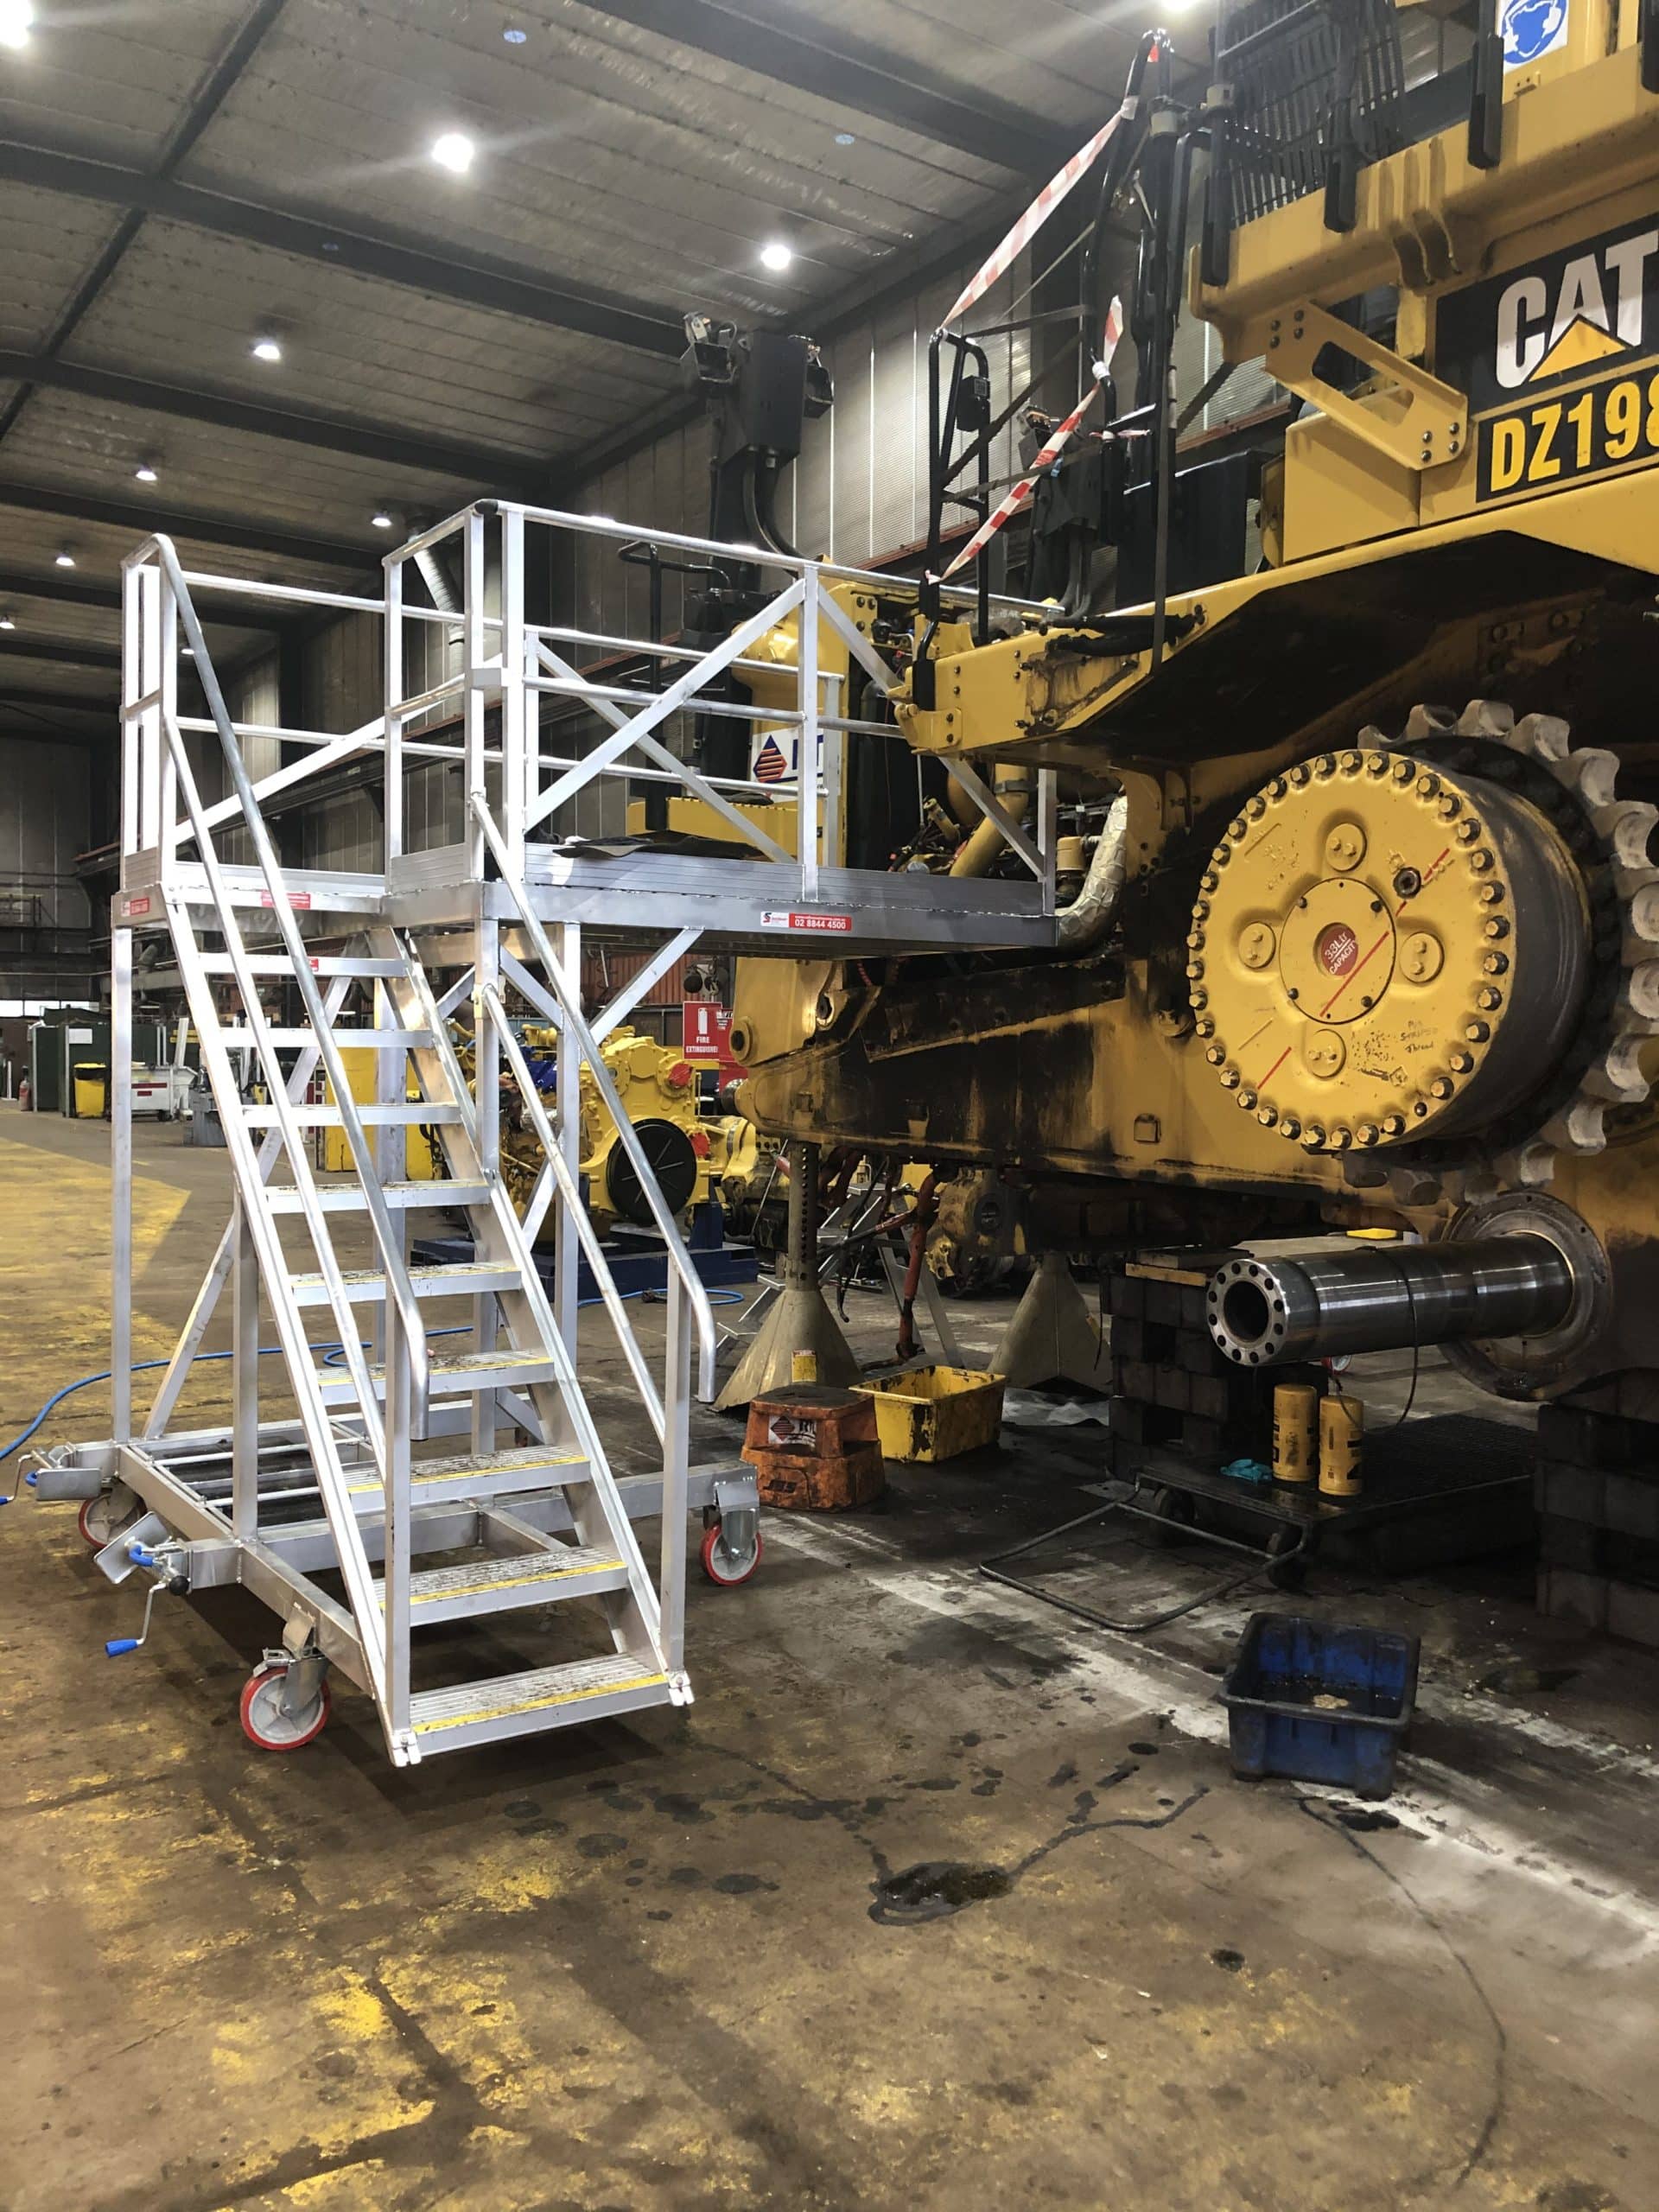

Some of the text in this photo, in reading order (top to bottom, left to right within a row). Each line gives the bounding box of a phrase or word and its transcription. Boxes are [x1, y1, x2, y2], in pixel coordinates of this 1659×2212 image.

[1496, 229, 1658, 389] CAT
[795, 918, 804, 927] 02
[827, 920, 847, 930] 4500
[1330, 939, 1356, 975] CAPACIT
